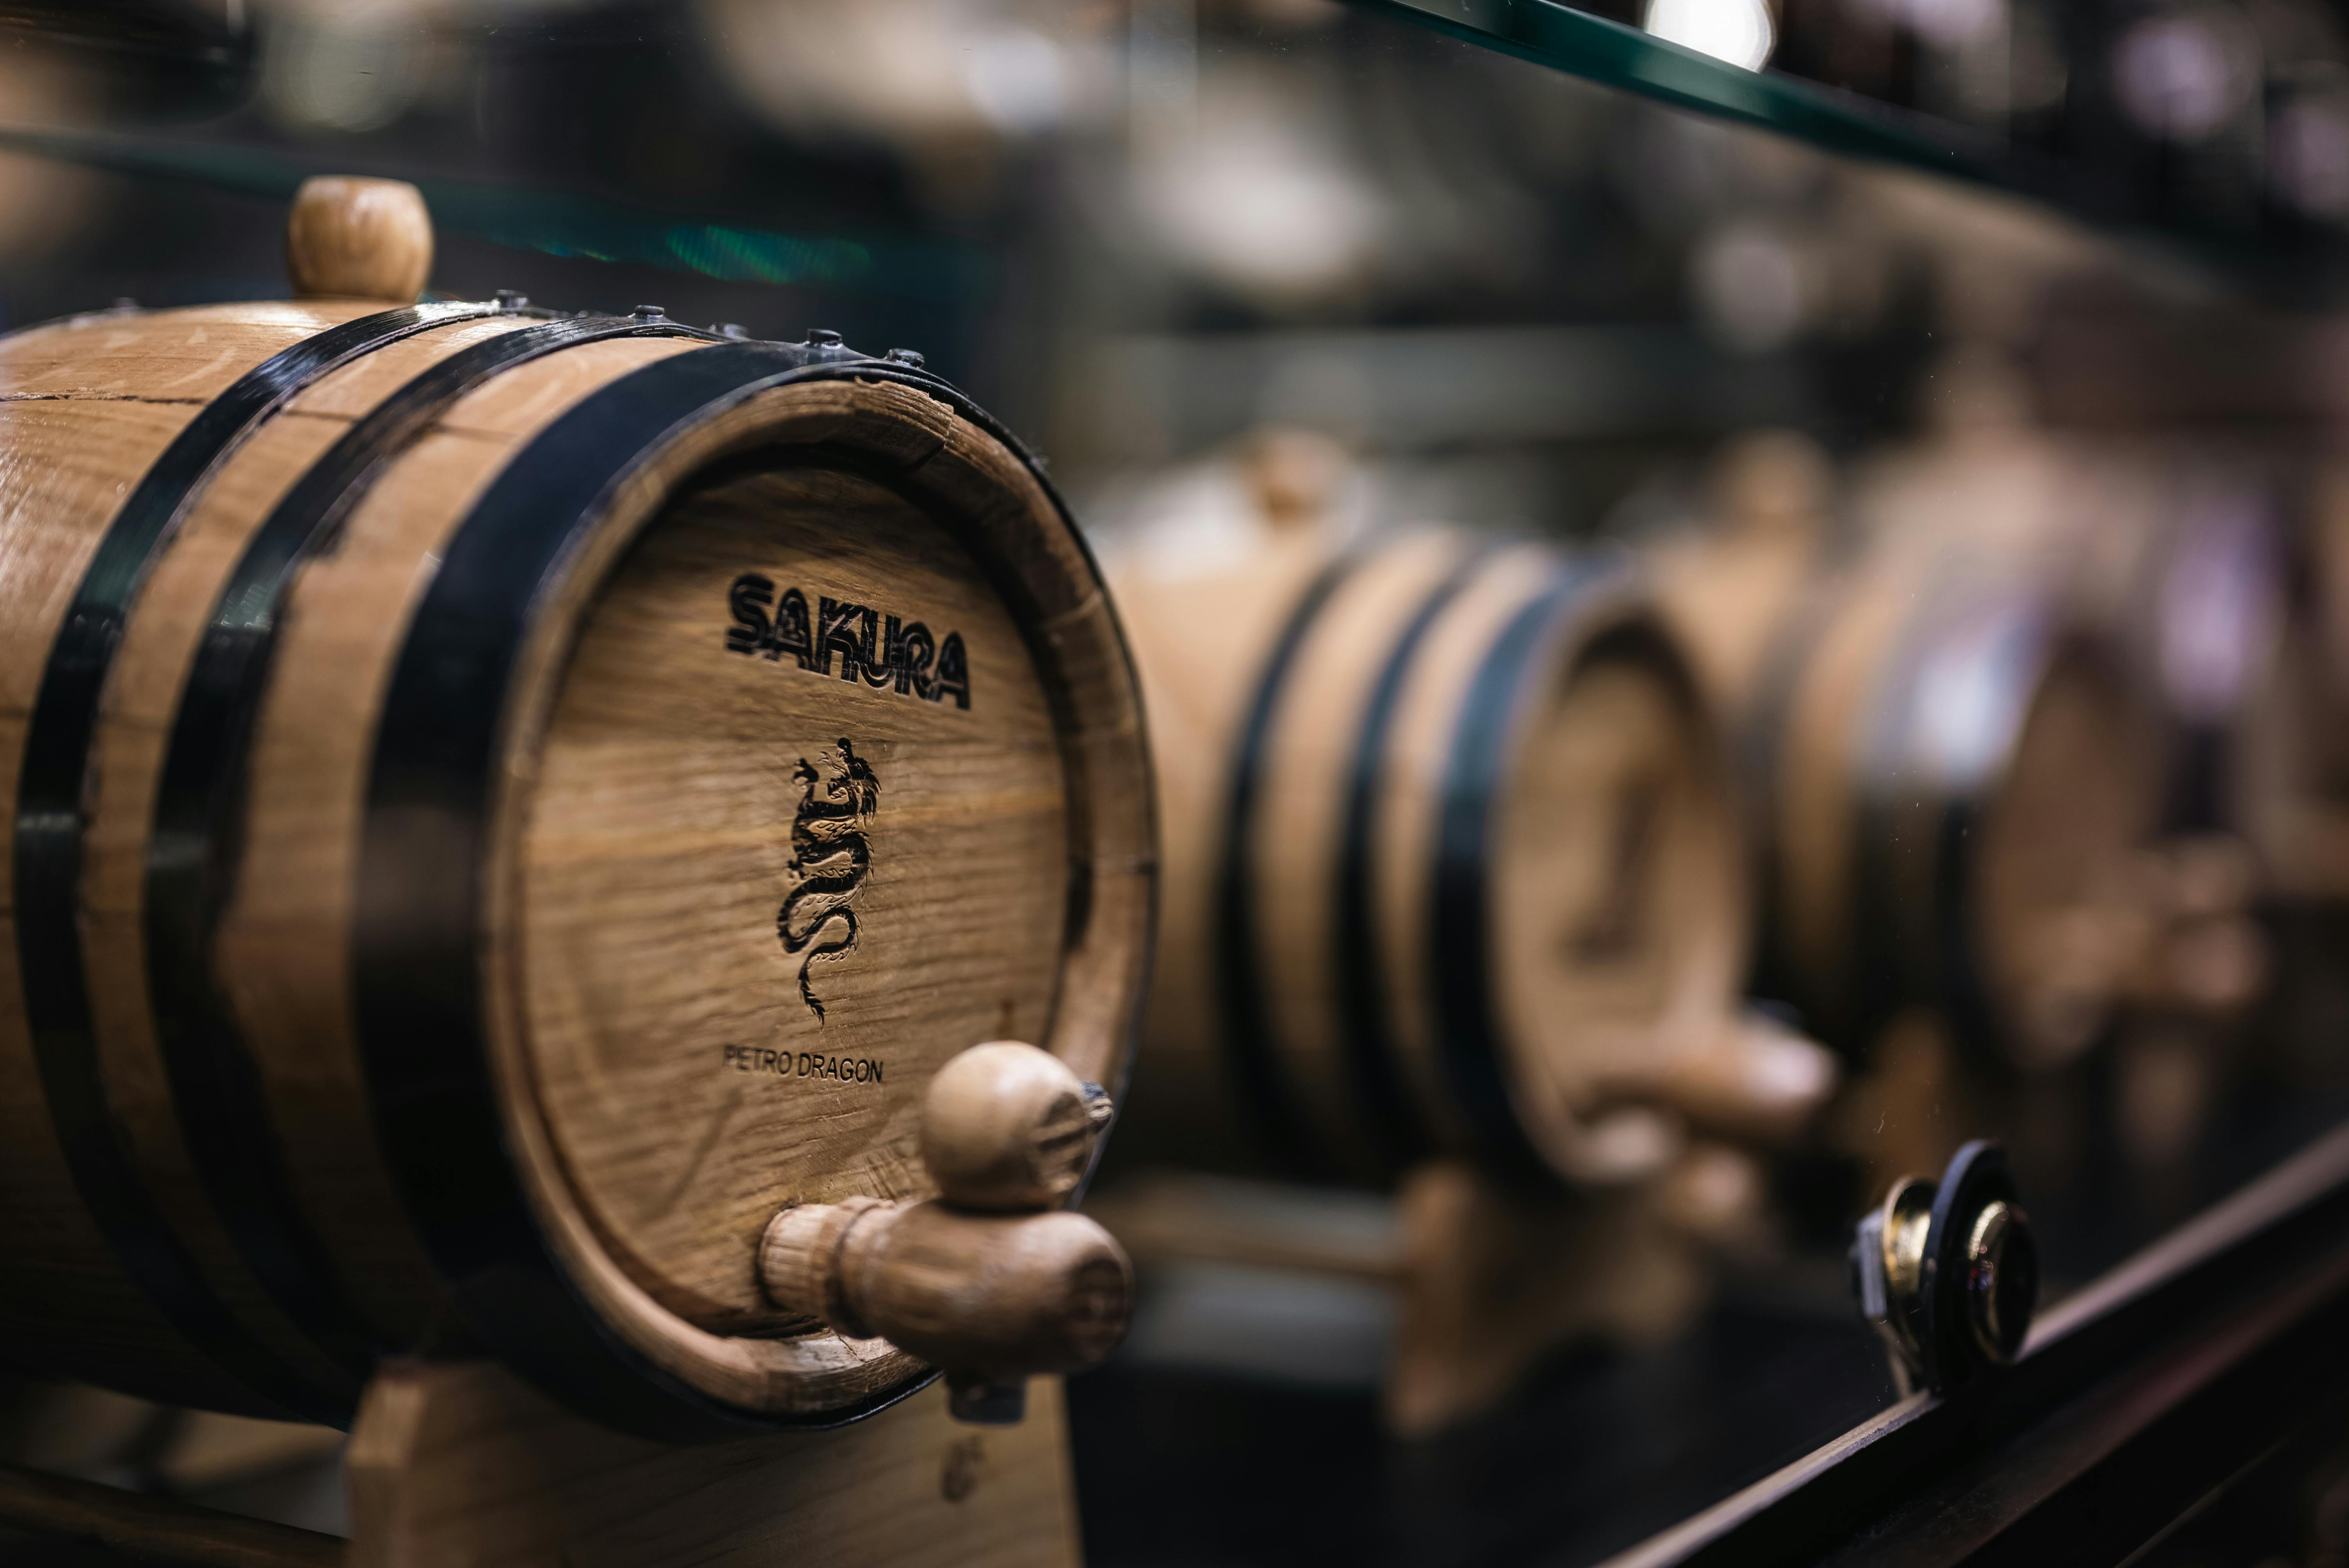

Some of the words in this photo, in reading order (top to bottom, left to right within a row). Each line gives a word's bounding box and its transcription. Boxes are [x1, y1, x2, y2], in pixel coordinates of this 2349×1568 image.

[725, 572, 971, 711] SAKURA
[724, 1044, 792, 1074] PETRO
[797, 1053, 884, 1083] DRAGON
